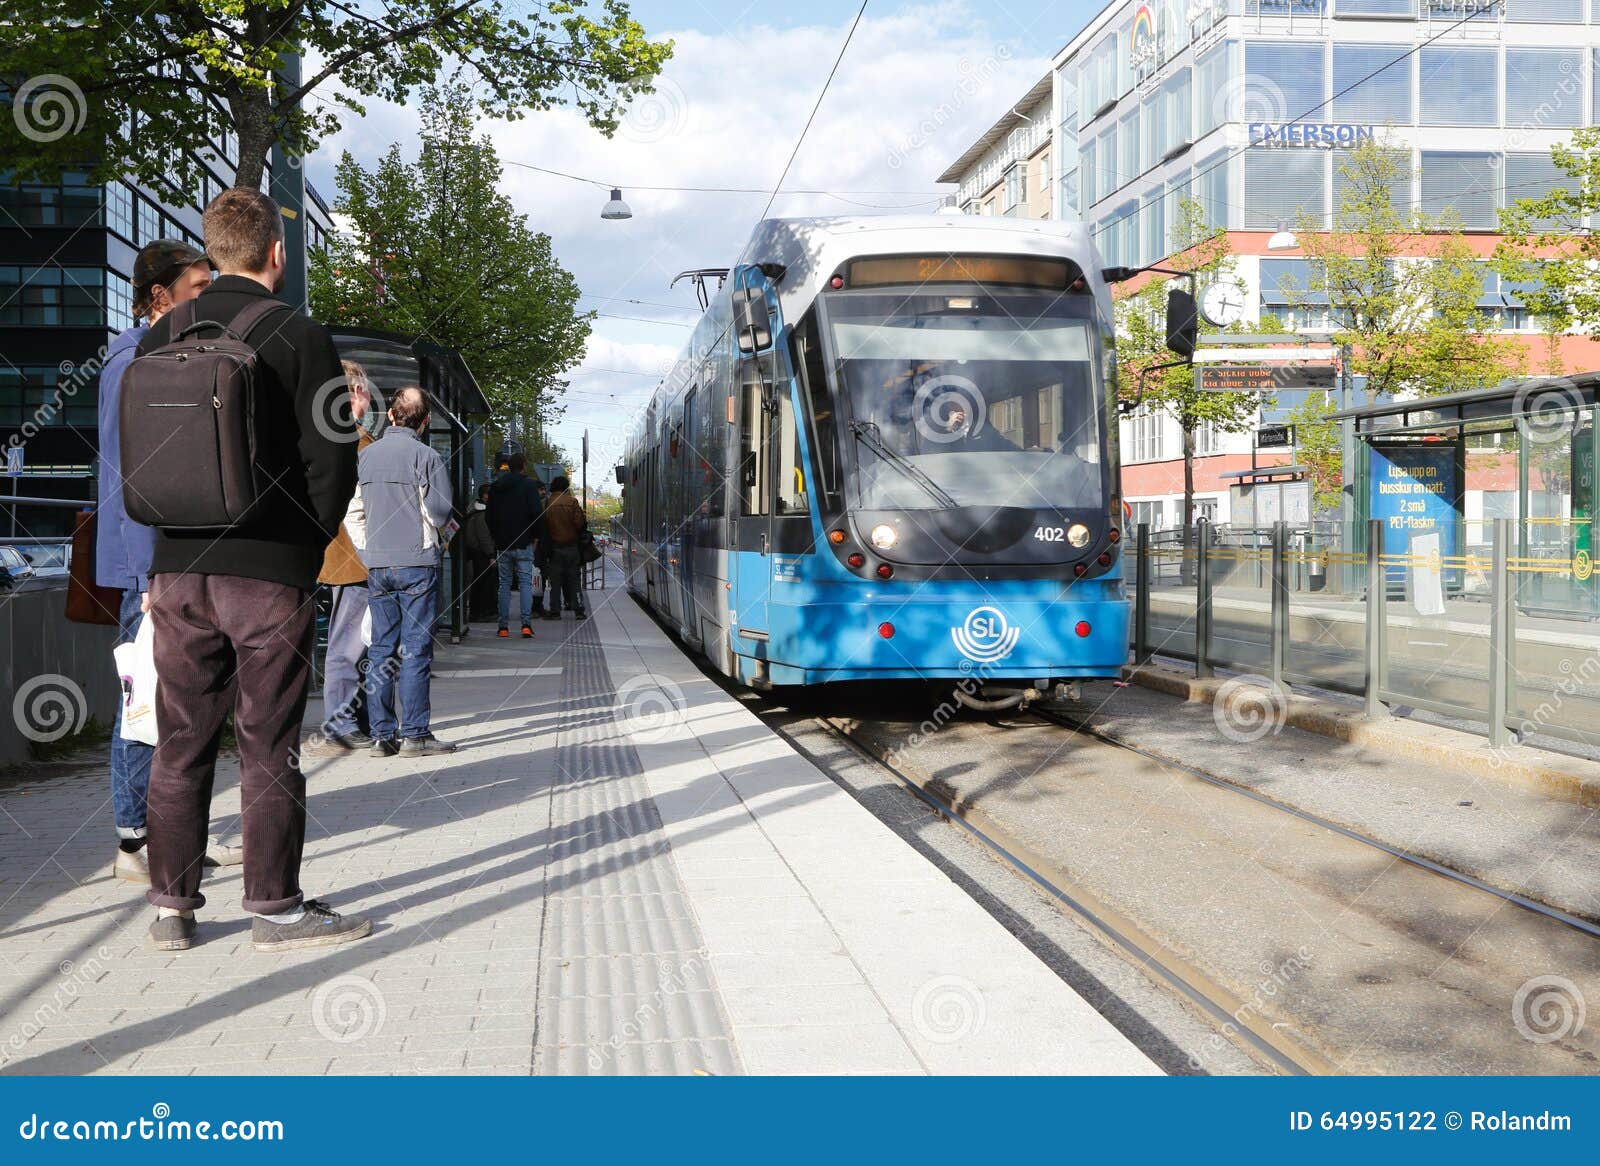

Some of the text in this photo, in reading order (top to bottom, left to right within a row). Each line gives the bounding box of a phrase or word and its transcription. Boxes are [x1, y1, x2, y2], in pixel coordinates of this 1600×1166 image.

[1249, 123, 1374, 142] EMERSON
[1426, 466, 1437, 477] en
[1413, 482, 1425, 494] en
[1400, 499, 1426, 513] 2 små
[1034, 526, 1065, 542] 402
[972, 617, 1000, 638] SL
